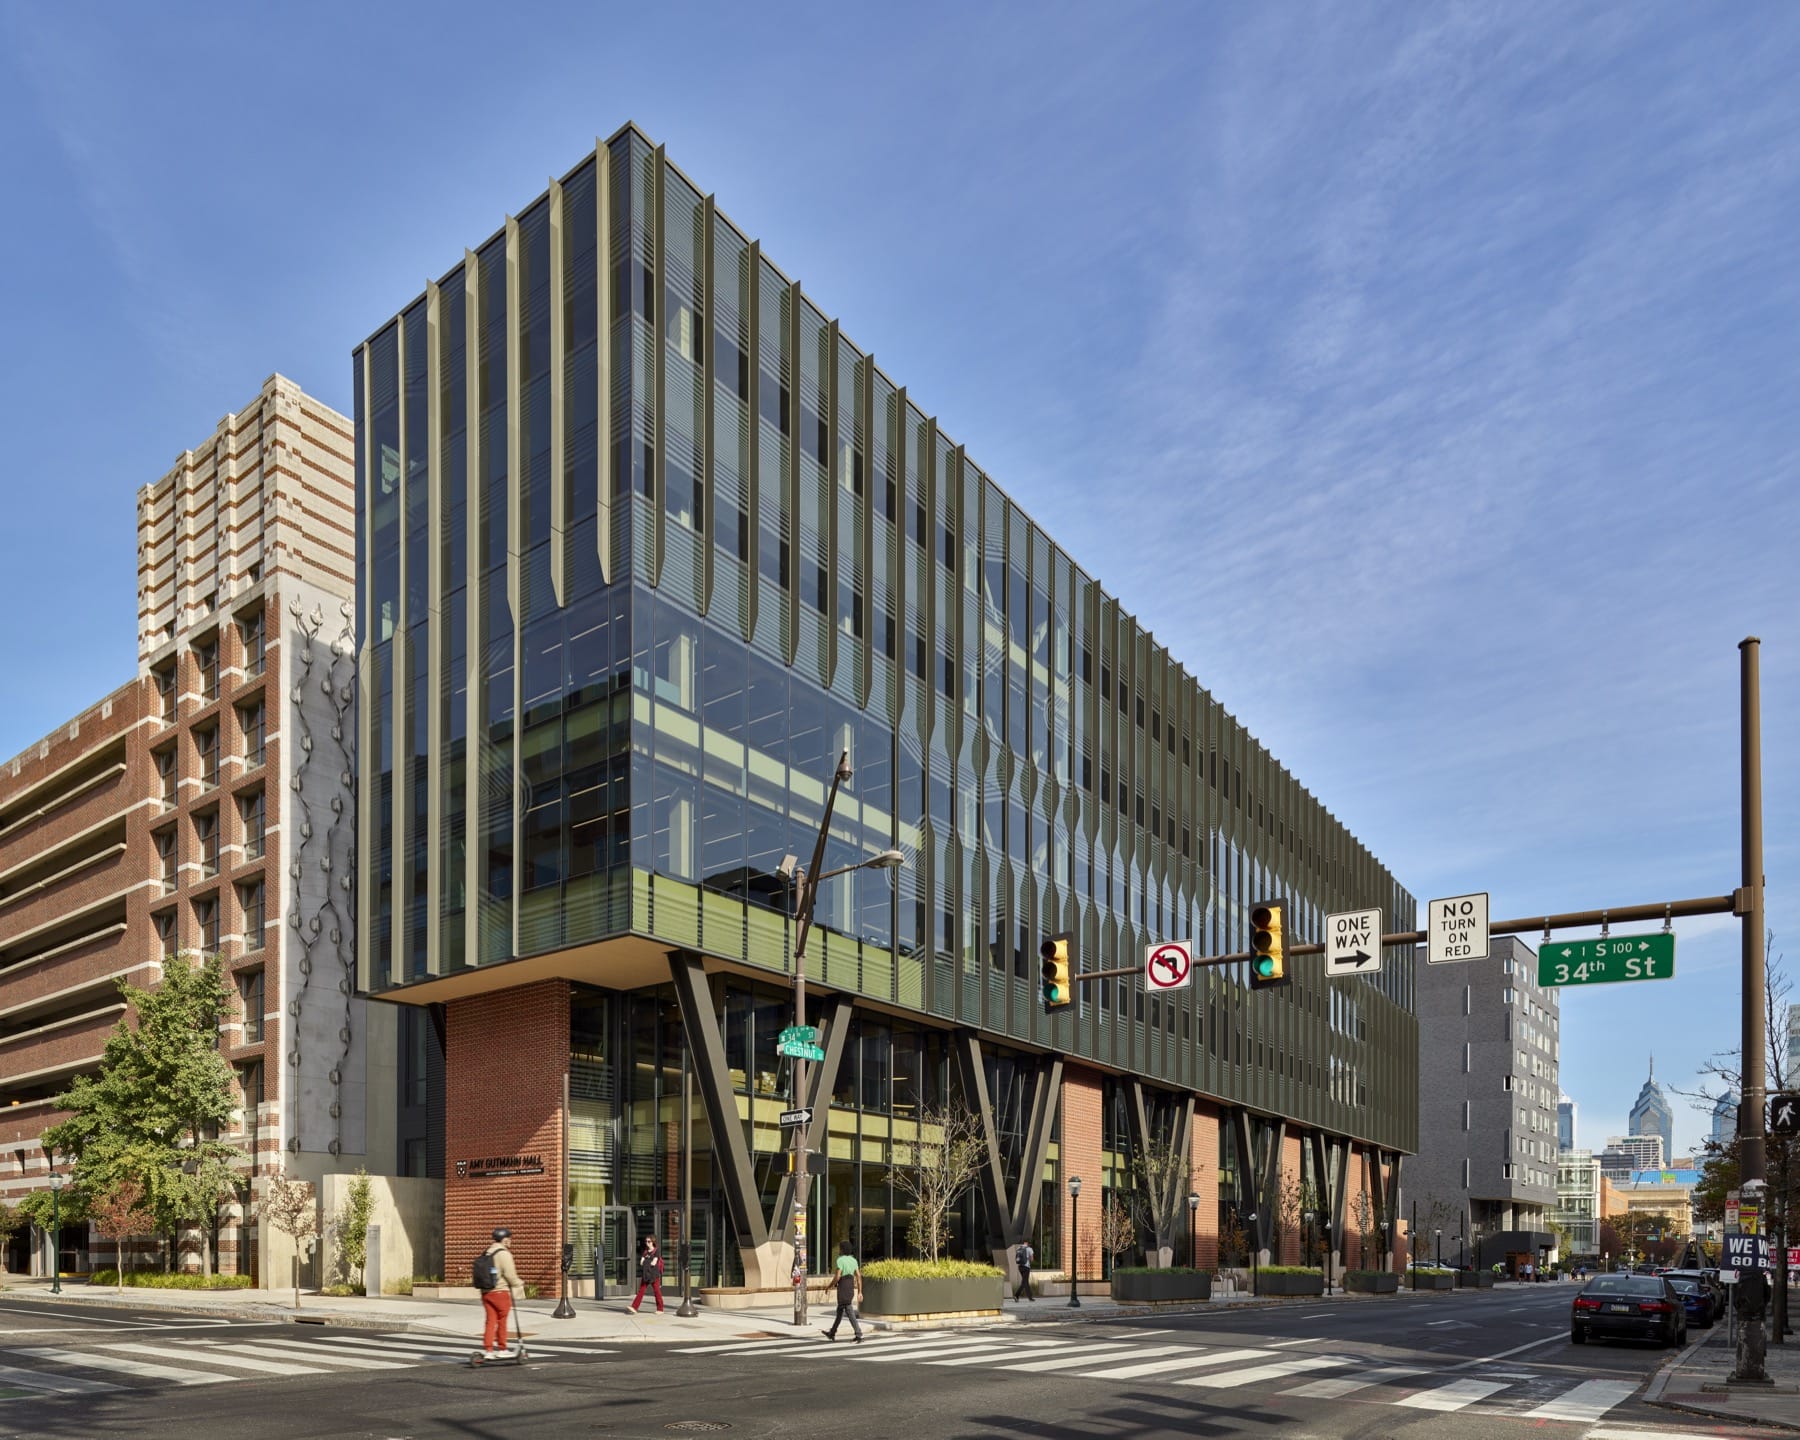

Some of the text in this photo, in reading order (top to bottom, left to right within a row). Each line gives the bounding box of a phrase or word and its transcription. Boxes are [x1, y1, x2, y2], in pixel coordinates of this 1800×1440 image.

[1443, 901, 1473, 918] NO
[1337, 916, 1370, 933] ONE
[1441, 917, 1476, 932] TURN
[1336, 932, 1371, 949] WAY
[1448, 931, 1468, 944] ON
[1445, 944, 1471, 957] RED
[1582, 942, 1633, 957] 1 S 100
[1554, 956, 1656, 983] 34th St
[785, 1044, 816, 1059] CHESTNUT
[469, 1154, 544, 1169] AMY GUTMANN HALL
[1729, 1238, 1753, 1254] WE
[1731, 1256, 1753, 1266] GO
